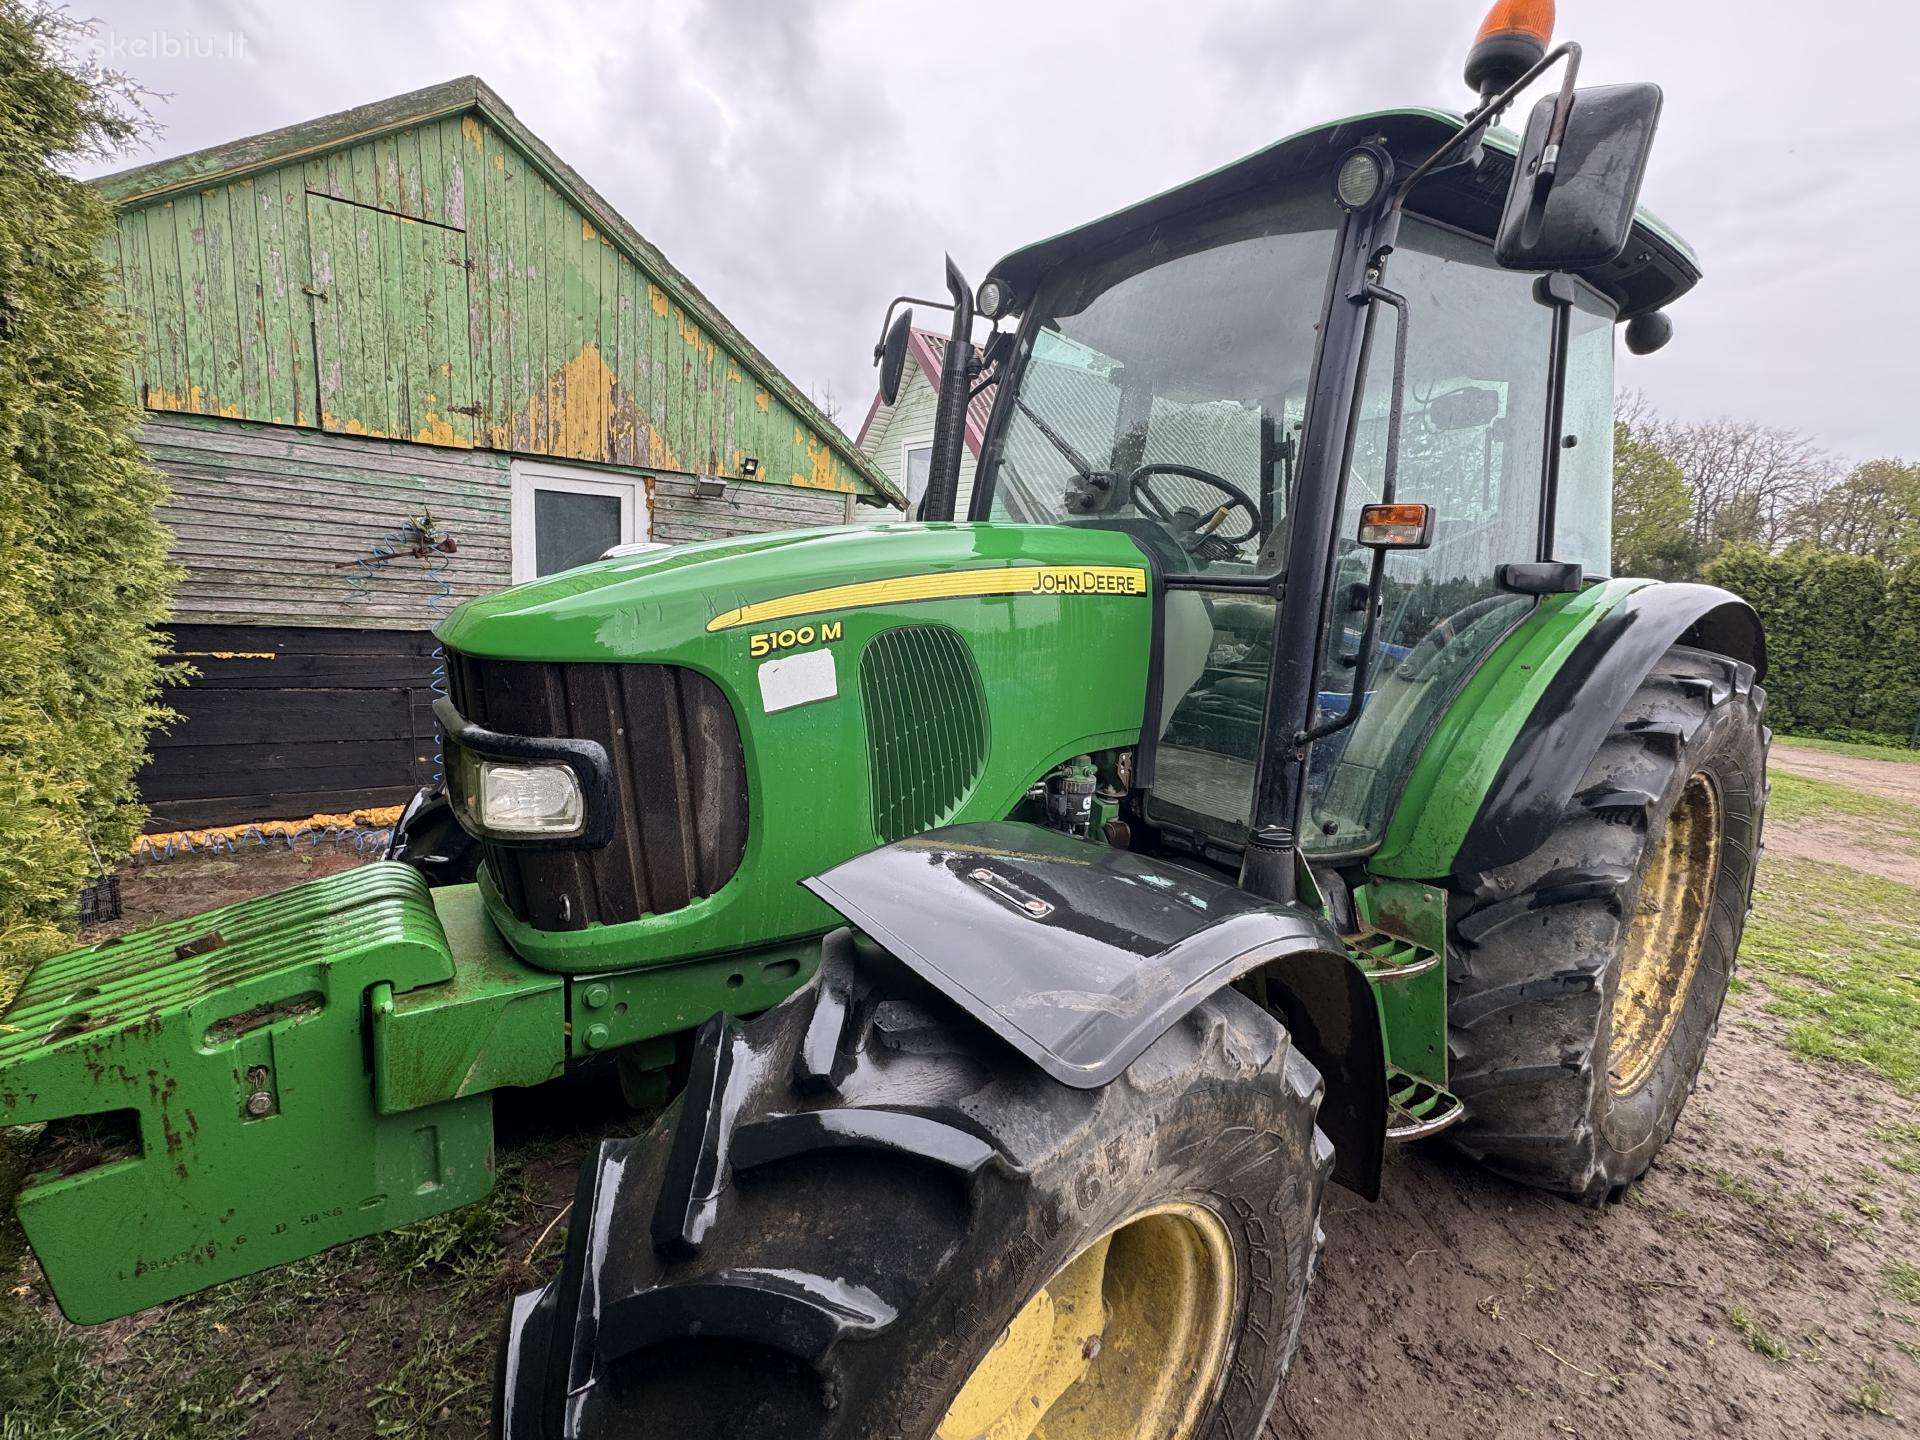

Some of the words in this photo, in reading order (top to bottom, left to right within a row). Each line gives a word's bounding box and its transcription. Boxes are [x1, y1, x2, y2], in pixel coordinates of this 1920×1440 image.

[1031, 571, 1081, 591] JOHN
[1083, 571, 1136, 592] DEERE
[750, 626, 816, 658] 5100
[821, 621, 842, 642] M
